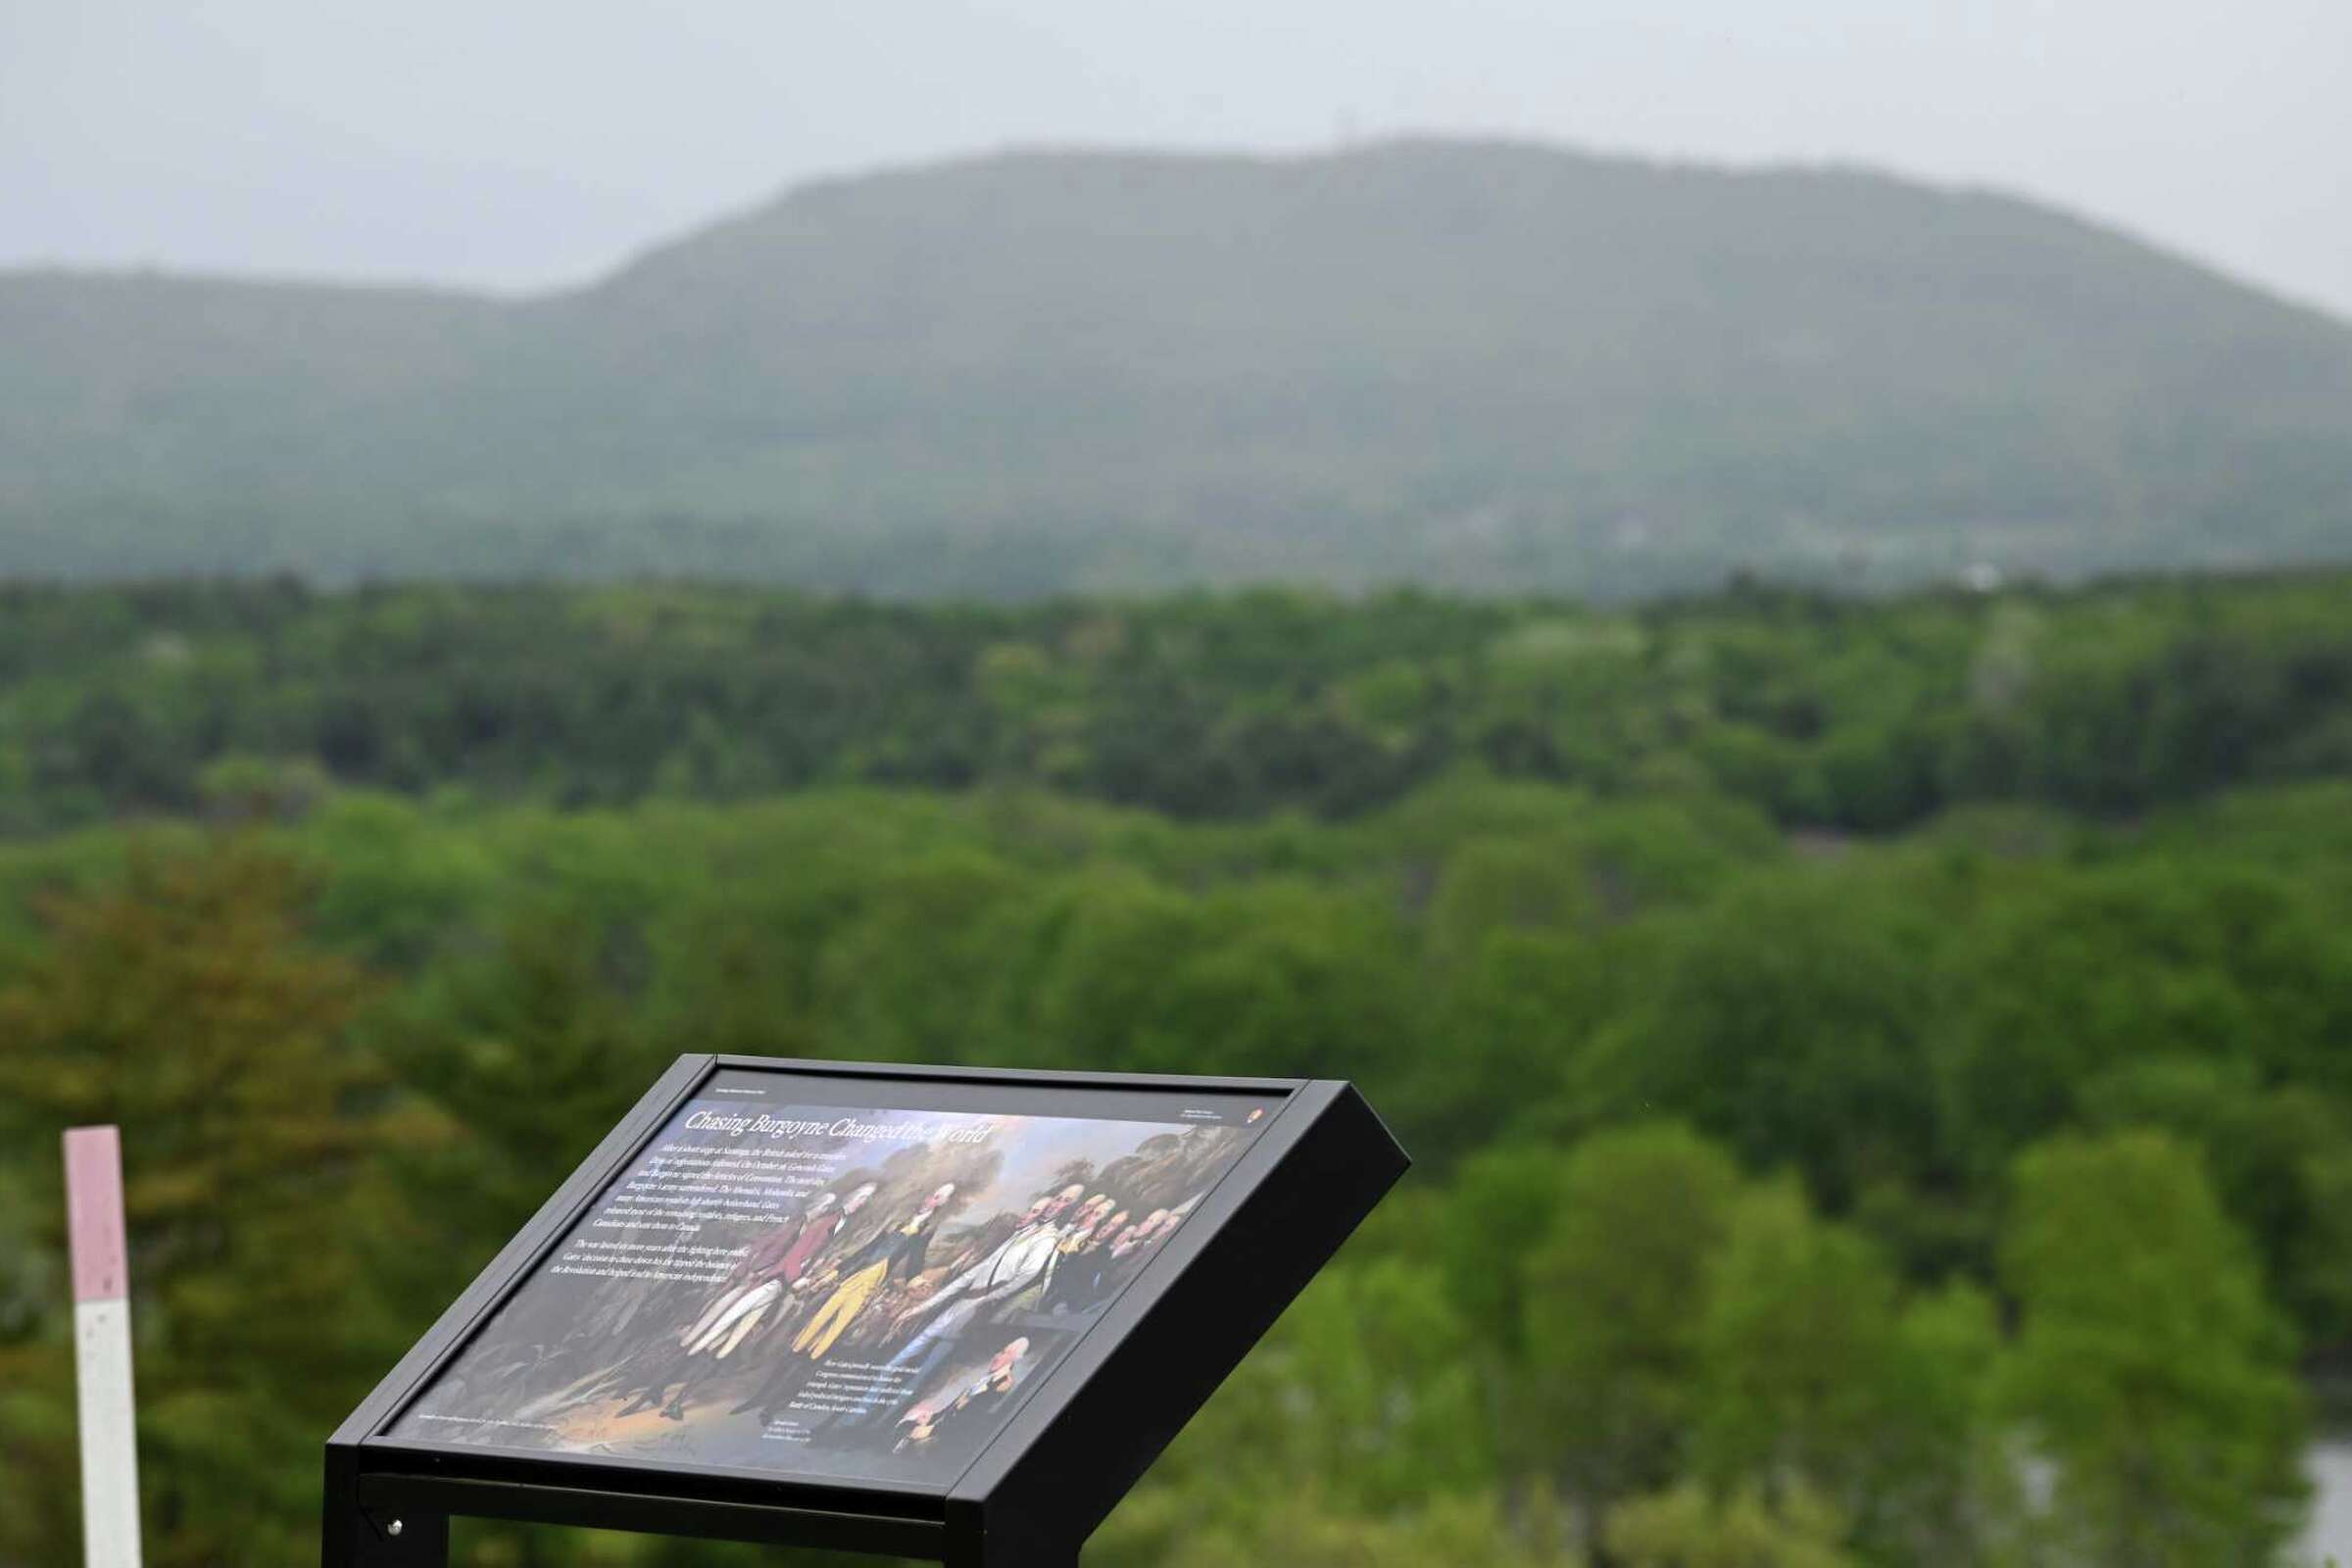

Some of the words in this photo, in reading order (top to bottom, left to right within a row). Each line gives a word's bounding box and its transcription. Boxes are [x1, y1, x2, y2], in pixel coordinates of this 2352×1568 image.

[685, 1110, 752, 1135] Chasing
[751, 1114, 830, 1139] Burgoyne
[828, 1117, 904, 1142] Changed
